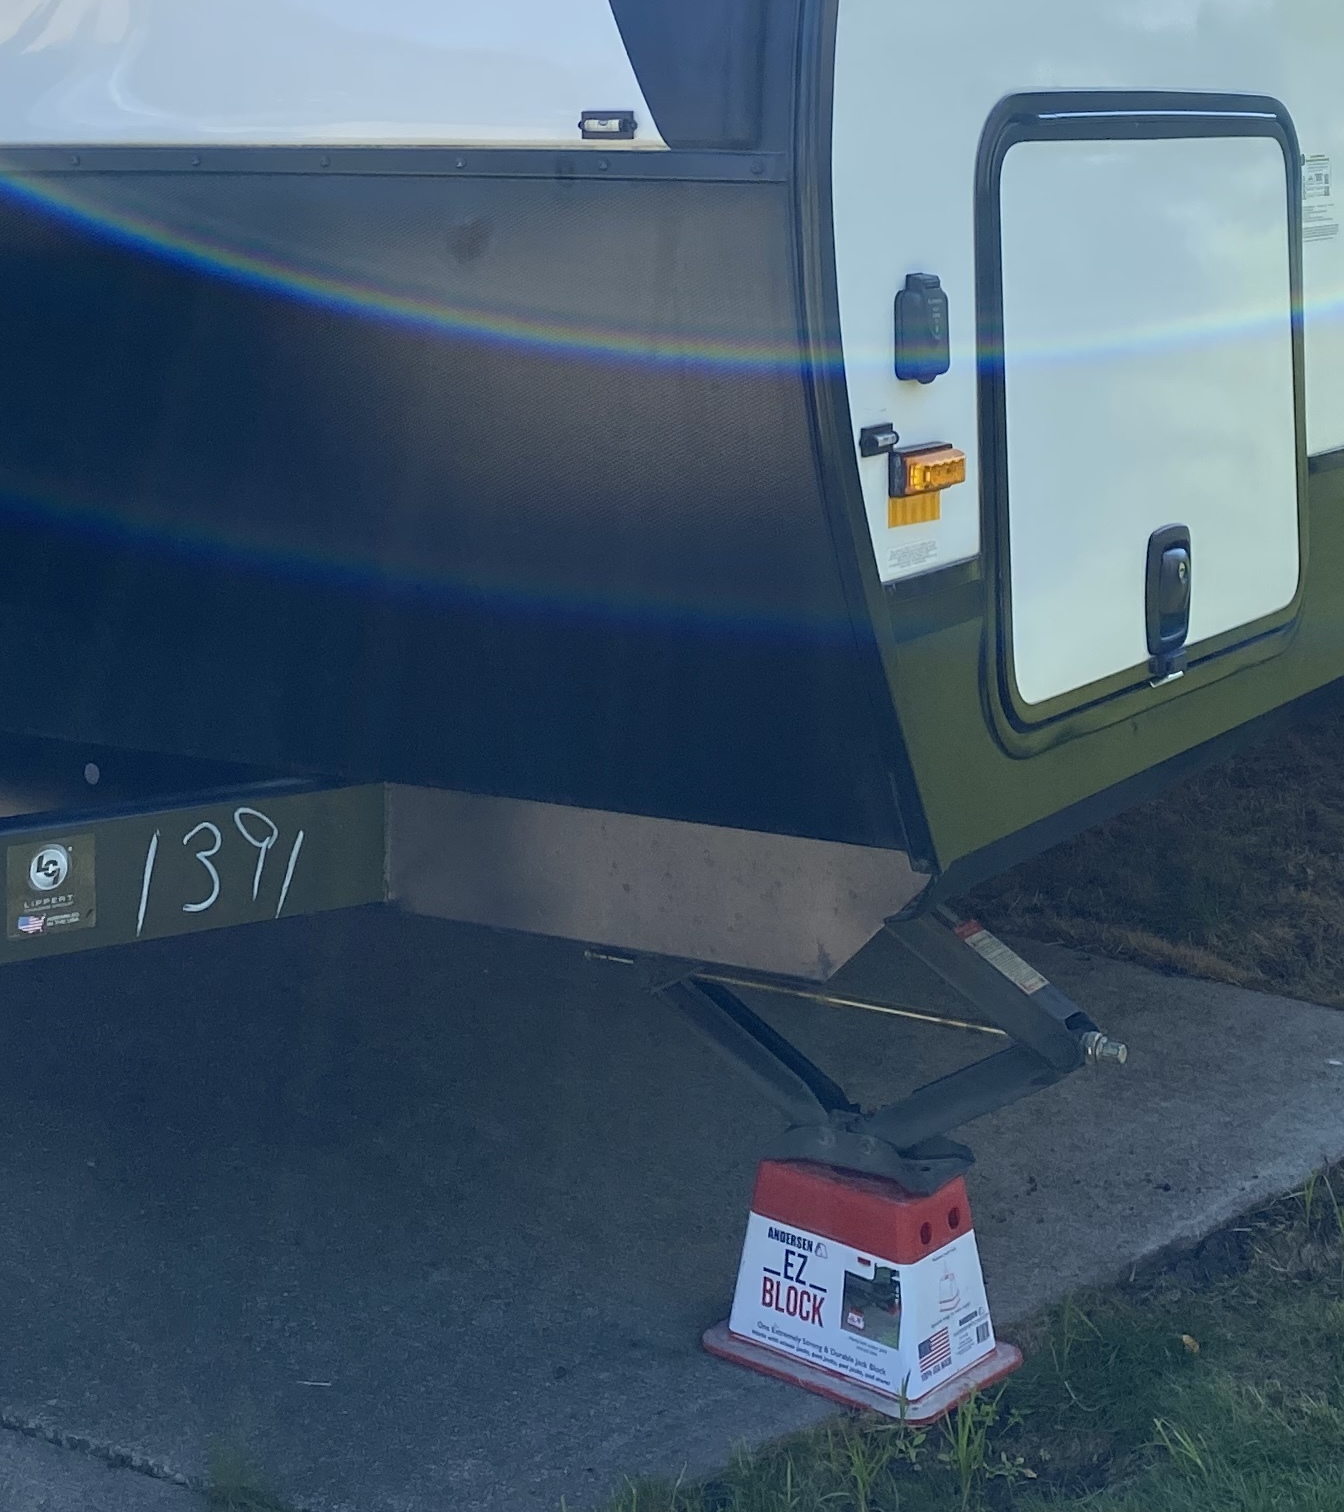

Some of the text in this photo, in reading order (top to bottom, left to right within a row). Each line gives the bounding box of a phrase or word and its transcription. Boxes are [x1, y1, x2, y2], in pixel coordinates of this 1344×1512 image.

[136, 807, 304, 938] 1391
[23, 894, 74, 909] LIPPERT
[767, 1226, 814, 1253] ANDERSEN
[783, 1249, 809, 1286] EZ
[761, 1276, 826, 1329] BLOCK
